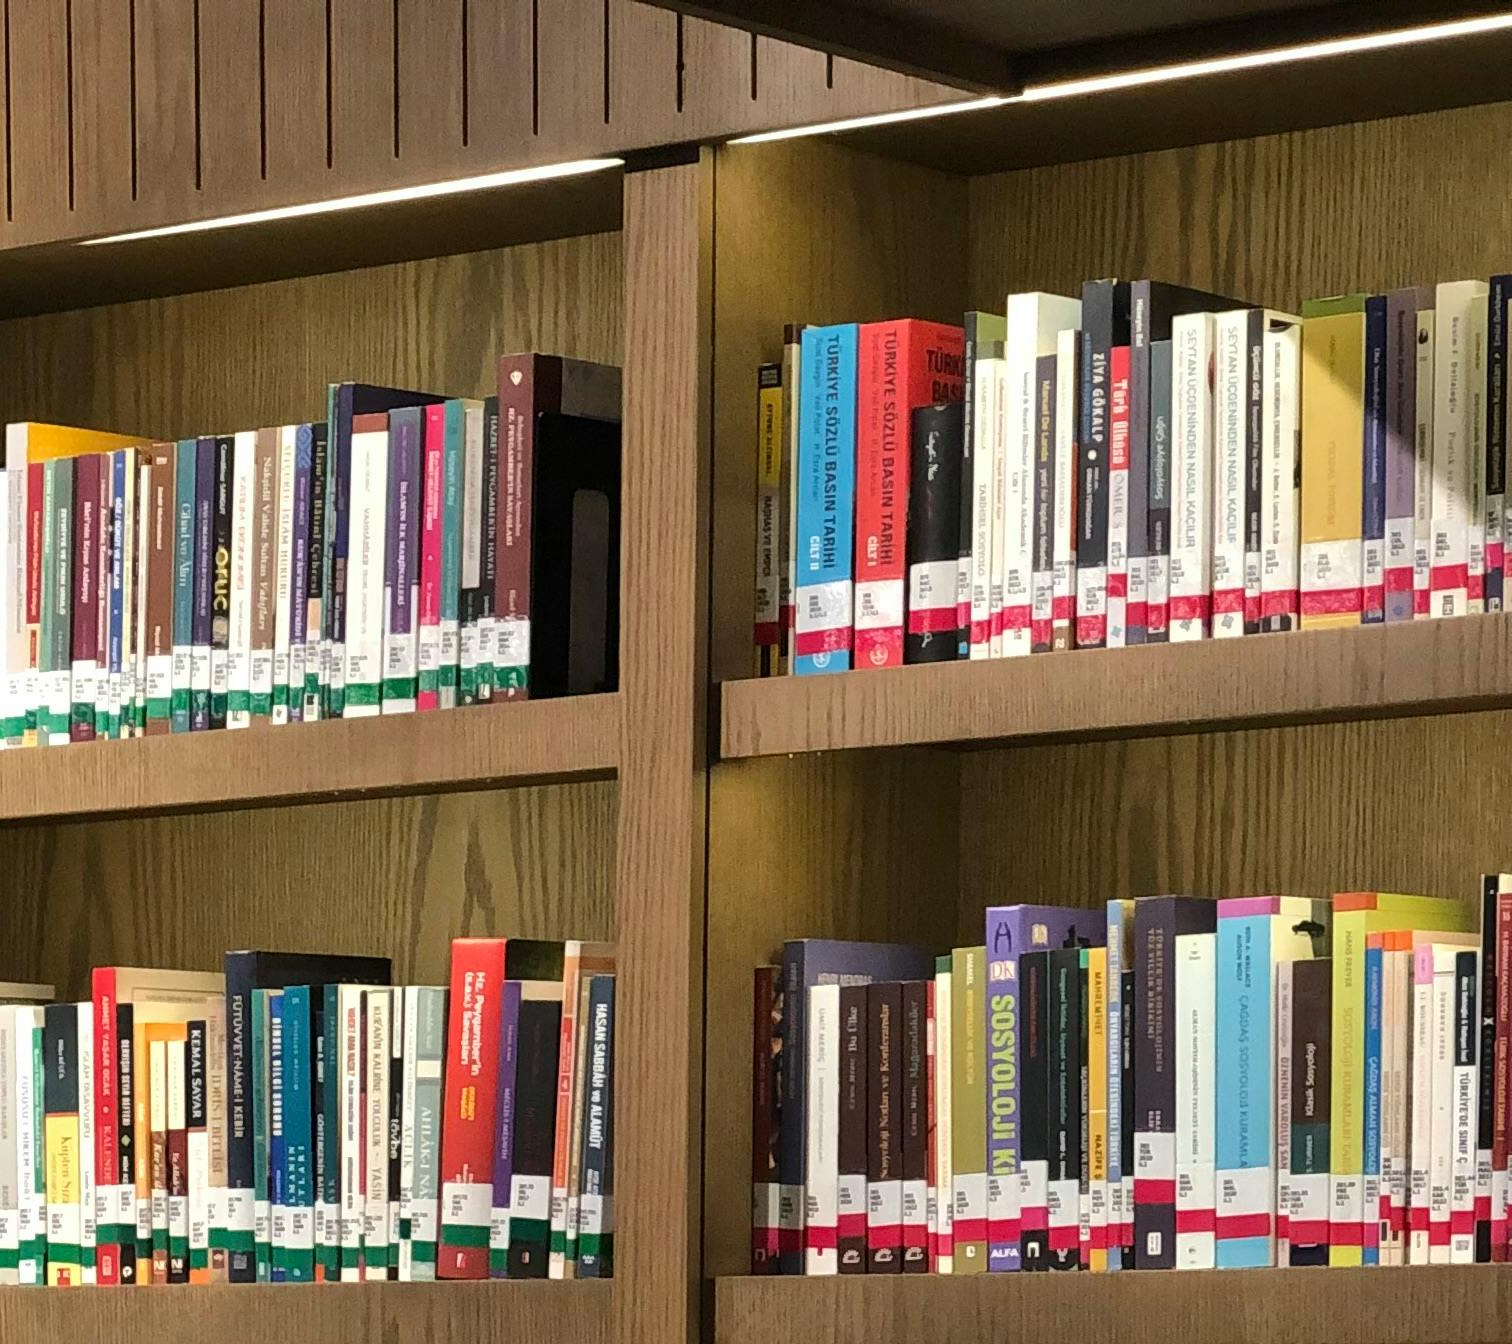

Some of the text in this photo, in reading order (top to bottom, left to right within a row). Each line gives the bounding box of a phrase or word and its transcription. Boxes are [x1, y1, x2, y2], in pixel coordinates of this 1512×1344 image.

[1091, 352, 1106, 442] ZİYA GÖKALP
[823, 334, 840, 569] TÜRKİYE SÖZLÜ BASIN TARİHİ
[879, 331, 898, 565] TÜRKİYE SÖZLÜ BASIN TARİHİ
[1185, 462, 1196, 498] NASIL
[1226, 459, 1238, 496] NASIL
[259, 542, 269, 577] Sultan
[593, 1002, 608, 1041] HASAN
[190, 1029, 202, 1118] KEMAL SAYAR
